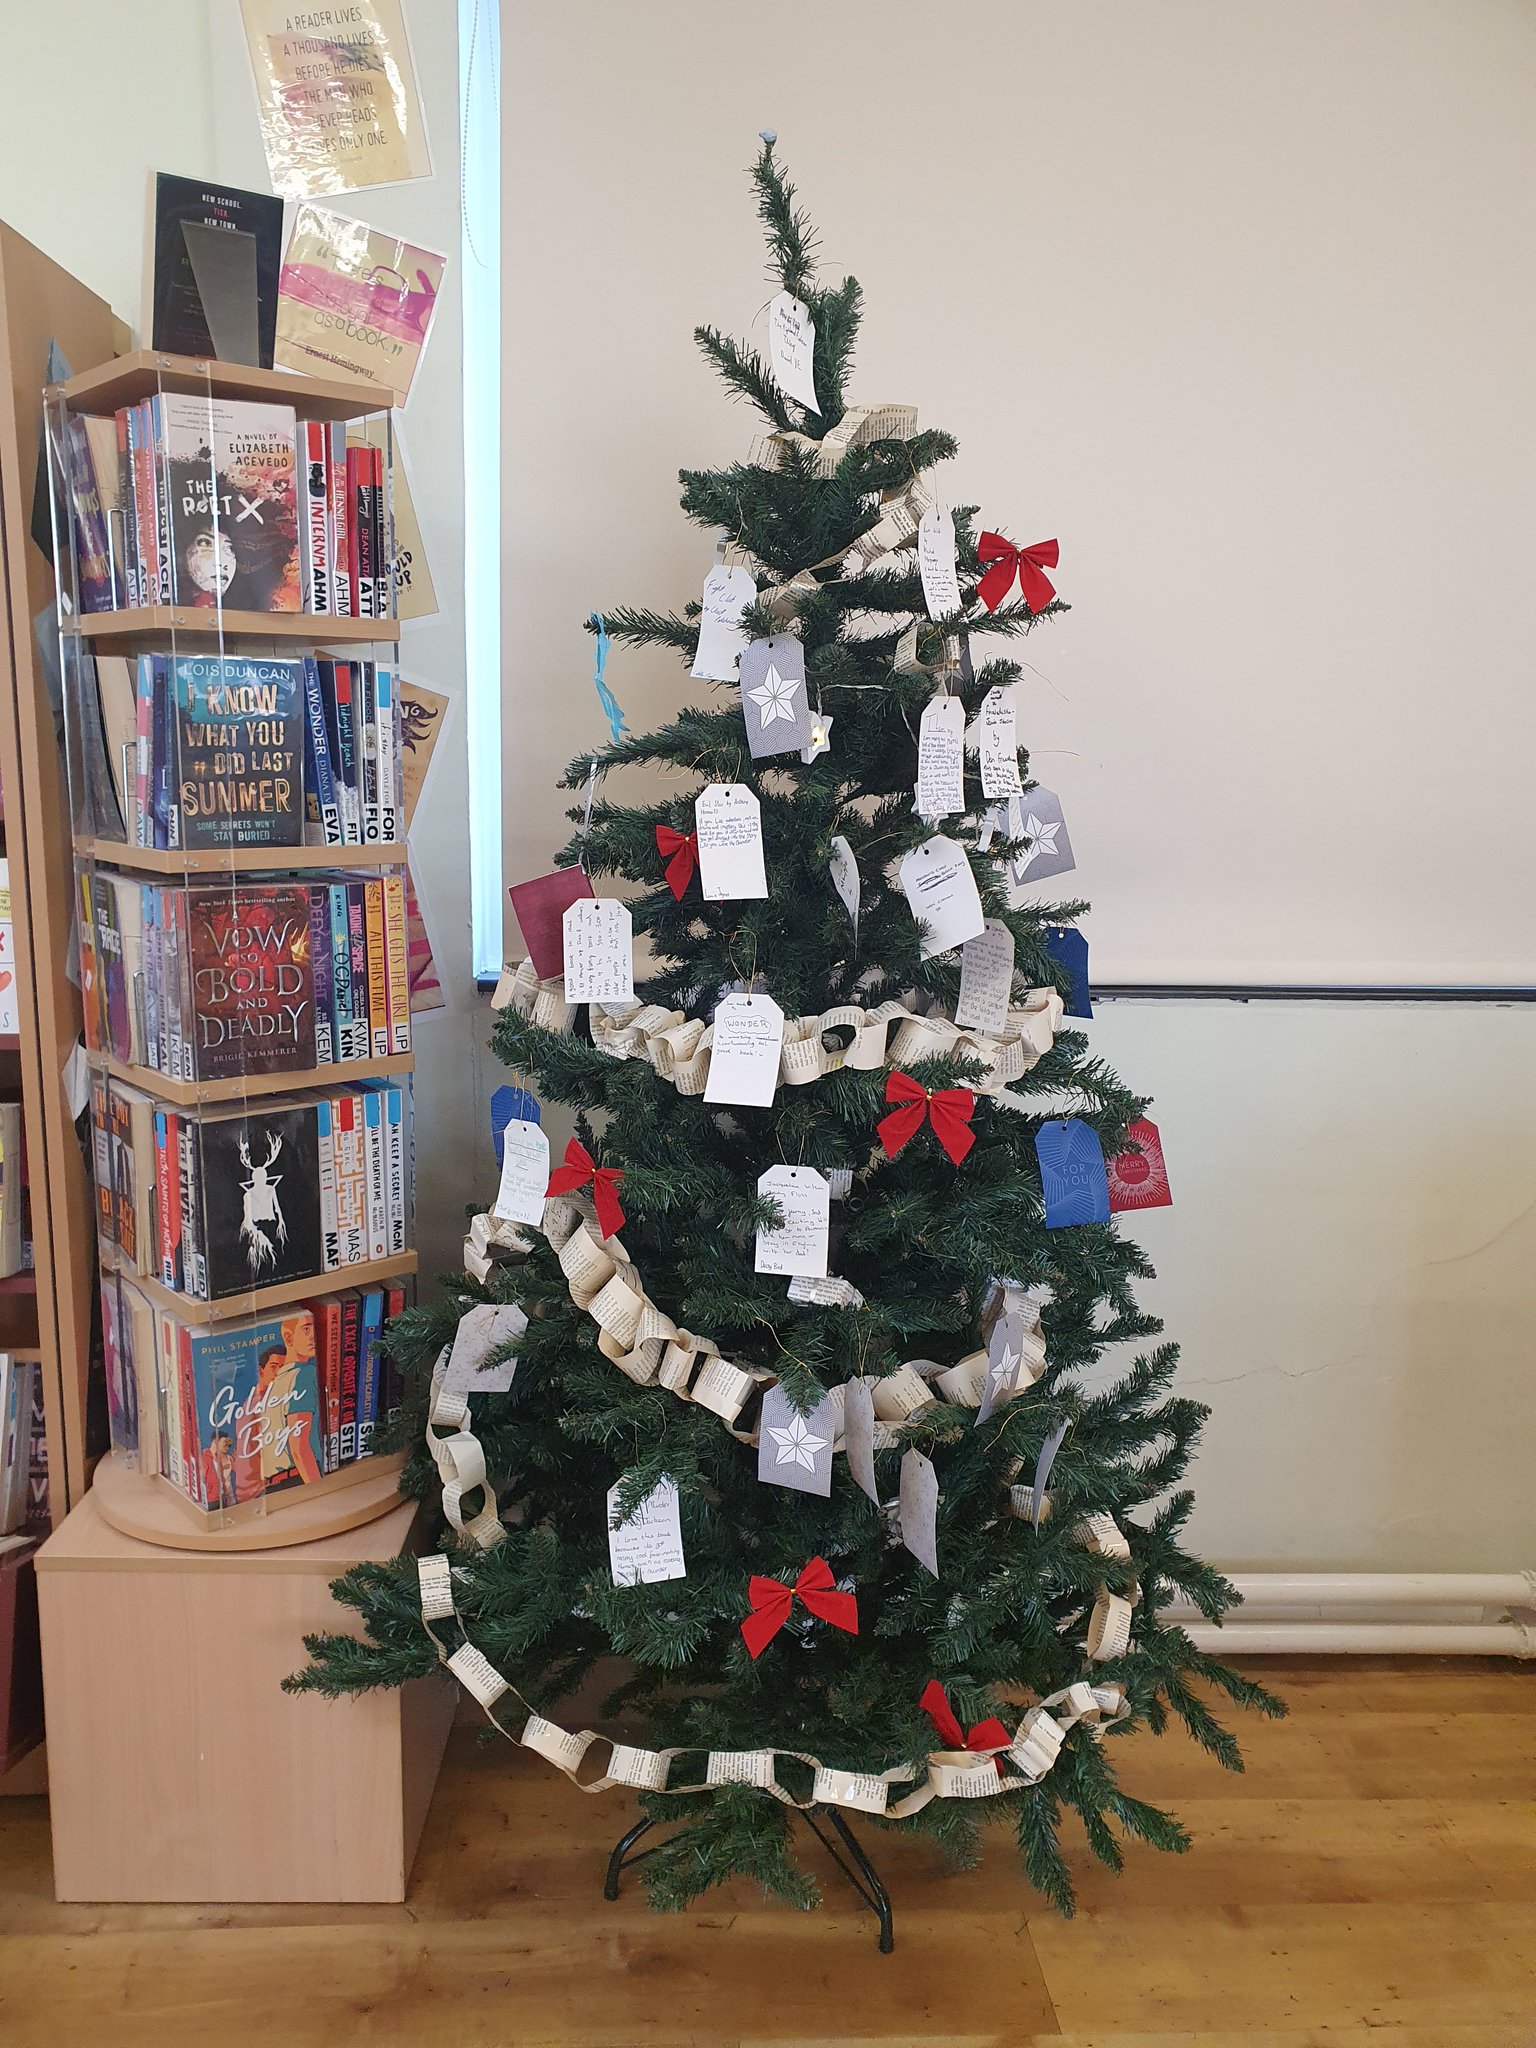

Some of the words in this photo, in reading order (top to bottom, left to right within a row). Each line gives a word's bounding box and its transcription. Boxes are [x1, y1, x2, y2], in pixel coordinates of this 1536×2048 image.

[286, 18, 293, 31] A
[295, 11, 333, 29] READER
[335, 6, 363, 25] LIVES
[284, 44, 291, 57] A
[292, 34, 345, 55] THOUSAND
[349, 30, 375, 47] LIVES
[295, 62, 331, 80] BEFORE
[334, 61, 347, 75] HE
[304, 89, 322, 104] THE
[349, 82, 374, 98] WHO
[338, 134, 365, 150] ONLY
[367, 130, 388, 146] ONE
[202, 194, 216, 204] NEW
[204, 217, 218, 226] NEW
[305, 345, 331, 361] Ernest
[330, 354, 375, 378] Hemingway
[229, 443, 289, 454] ELIZABETH
[235, 456, 288, 468] ACEVEDO
[186, 479, 214, 494] THE
[235, 494, 264, 525] X
[361, 528, 369, 555] DEAN
[336, 576, 350, 616] AHM
[360, 581, 373, 617] ATT
[184, 664, 219, 677] LOIS
[226, 665, 290, 680] DUNCAN
[187, 683, 195, 711] I
[207, 684, 278, 715] KNOW
[185, 723, 239, 747] WHAT
[245, 721, 285, 746] YOU
[308, 688, 327, 755] WONDER
[318, 760, 329, 791] DIANA
[214, 752, 246, 775] DID
[251, 751, 294, 772] LAST
[342, 743, 354, 768] Beach
[180, 778, 292, 816] SUMMER
[196, 821, 217, 831] SOME
[325, 809, 340, 843] EVA
[347, 823, 358, 842] FIT
[366, 808, 379, 839] FLO
[382, 807, 394, 841] FOR
[244, 897, 276, 905] bestselling
[335, 894, 343, 917] KING
[309, 893, 326, 936] DEFY
[350, 904, 362, 934] TAKING
[388, 913, 404, 933] SHE
[203, 918, 294, 958] VOW
[370, 931, 382, 953] ALL
[389, 938, 405, 963] GETS
[240, 952, 258, 963] SO
[353, 946, 365, 973] SPACE
[371, 955, 383, 981] THIS
[195, 964, 304, 1005] BOLD
[313, 952, 329, 1003] NIGHT
[391, 967, 406, 991] THE
[237, 998, 268, 1011] AND
[372, 984, 384, 1012] TIME
[198, 1001, 308, 1049] DEADLY
[727, 1020, 768, 1028] WONDER
[317, 1026, 331, 1062] KEM
[341, 1029, 353, 1058] KIN
[354, 1021, 367, 1059] KWA
[374, 1030, 386, 1055] LIP
[395, 1025, 407, 1049] LIP
[184, 1047, 192, 1076] KEM
[248, 1047, 297, 1058] KEMMERER
[372, 1138, 379, 1146] BE
[391, 1138, 399, 1160] KEEP
[372, 1160, 380, 1182] DEATH
[1063, 1164, 1085, 1175] FOR
[1118, 1160, 1145, 1169] MERRY
[373, 1183, 381, 1191] OF
[391, 1172, 400, 1201] SECRET
[1063, 1175, 1090, 1187] YOU
[161, 1176, 170, 1212] SAINTS
[374, 1191, 381, 1202] ME
[325, 1232, 339, 1267] MAF
[331, 1312, 338, 1325] WE
[230, 1333, 276, 1350] STAMPER
[344, 1324, 357, 1353] EXACT
[330, 1344, 338, 1393] EVERYTHING
[342, 1355, 357, 1394] OPPOSITE
[365, 1345, 374, 1382] OTORIOUS
[208, 1382, 307, 1428] Golden
[238, 1417, 310, 1459] Boys
[342, 1427, 354, 1456] STE
